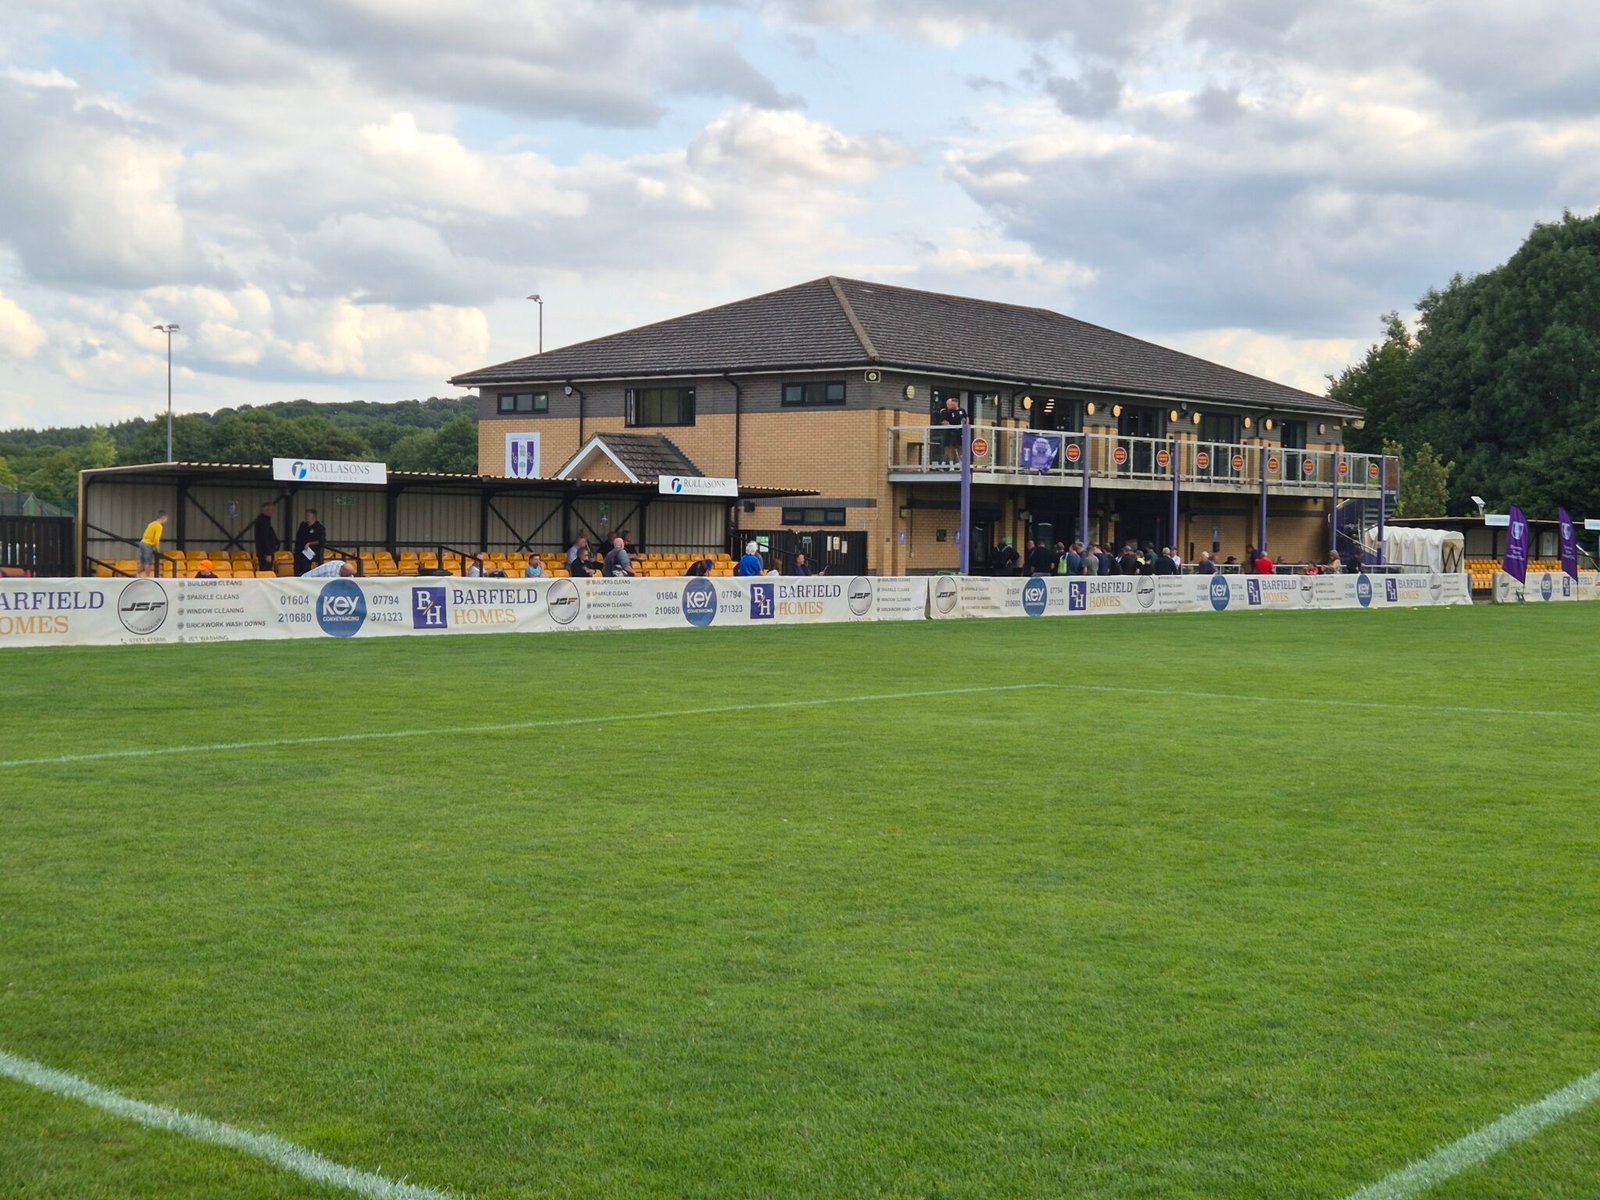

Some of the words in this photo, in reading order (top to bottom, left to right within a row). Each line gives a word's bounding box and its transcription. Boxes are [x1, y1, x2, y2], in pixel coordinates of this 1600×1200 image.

[309, 462, 370, 474] ROLLASONS
[683, 478, 726, 488] ROLLASONS
[1089, 582, 1133, 593] BARFIELD
[1262, 580, 1297, 590] BARFIELD
[656, 592, 678, 600] 01604
[721, 590, 742, 599] 07794
[779, 584, 841, 598] BARFIELD
[280, 595, 310, 605] 01604
[372, 595, 399, 605] 07794
[453, 588, 538, 605] BARFIELD
[550, 597, 578, 605] JSF
[120, 602, 166, 612] JSF
[1089, 596, 1121, 608] HOMES
[655, 606, 680, 615] 210680
[720, 605, 743, 613] 371323
[779, 601, 824, 615] HOMES
[278, 613, 312, 623] 210680
[370, 612, 403, 622] 371323
[454, 608, 517, 624] HOMES
